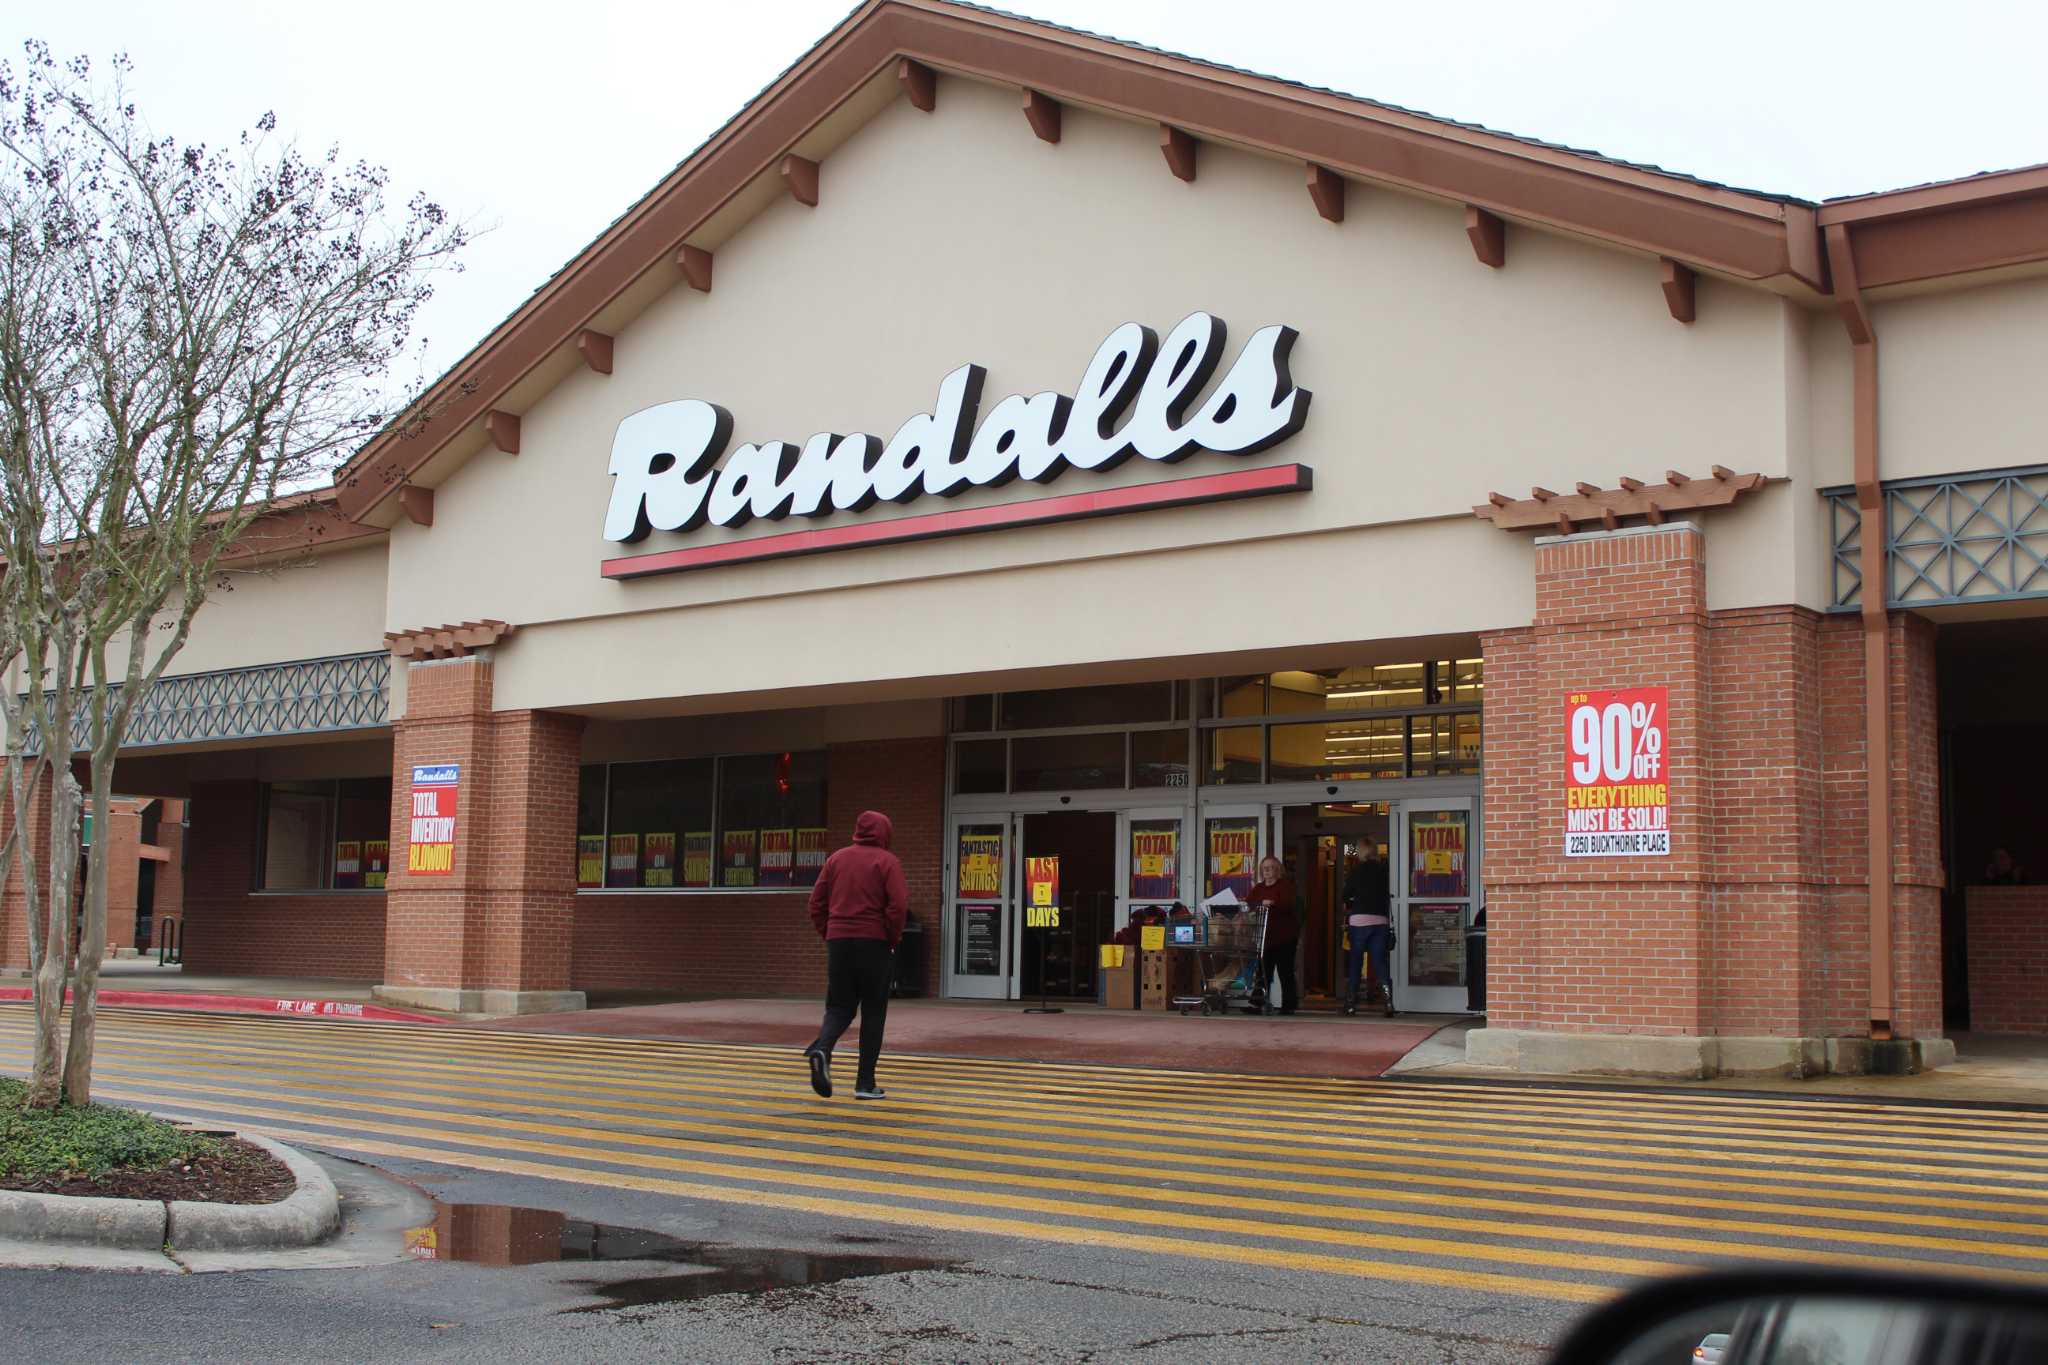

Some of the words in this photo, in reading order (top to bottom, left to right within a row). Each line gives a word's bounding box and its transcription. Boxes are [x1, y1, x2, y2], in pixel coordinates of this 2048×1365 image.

[602, 311, 1312, 543] Randalls
[1571, 701, 1662, 784] 90%
[414, 769, 457, 782] Randalls
[1633, 753, 1661, 780] OFF
[1166, 774, 1189, 787] 2250
[412, 792, 439, 817] TOTAL
[1568, 784, 1667, 809] EVERYTHING
[410, 817, 456, 843] INVENTORY
[1567, 808, 1605, 832] MUST
[1607, 808, 1626, 831] BE
[1627, 806, 1667, 830] SOLD!
[1135, 834, 1173, 855] TOTAL
[1213, 832, 1253, 854] TOTAL
[1417, 827, 1463, 850] TOTAL
[1570, 835, 1589, 854] 2250
[1590, 834, 1641, 853] BUCKTHORNE
[1642, 833, 1667, 852] PLACE
[409, 843, 454, 871] BLOWOUT
[960, 863, 998, 892] SAVINGS
[1026, 906, 1060, 928] DAYS
